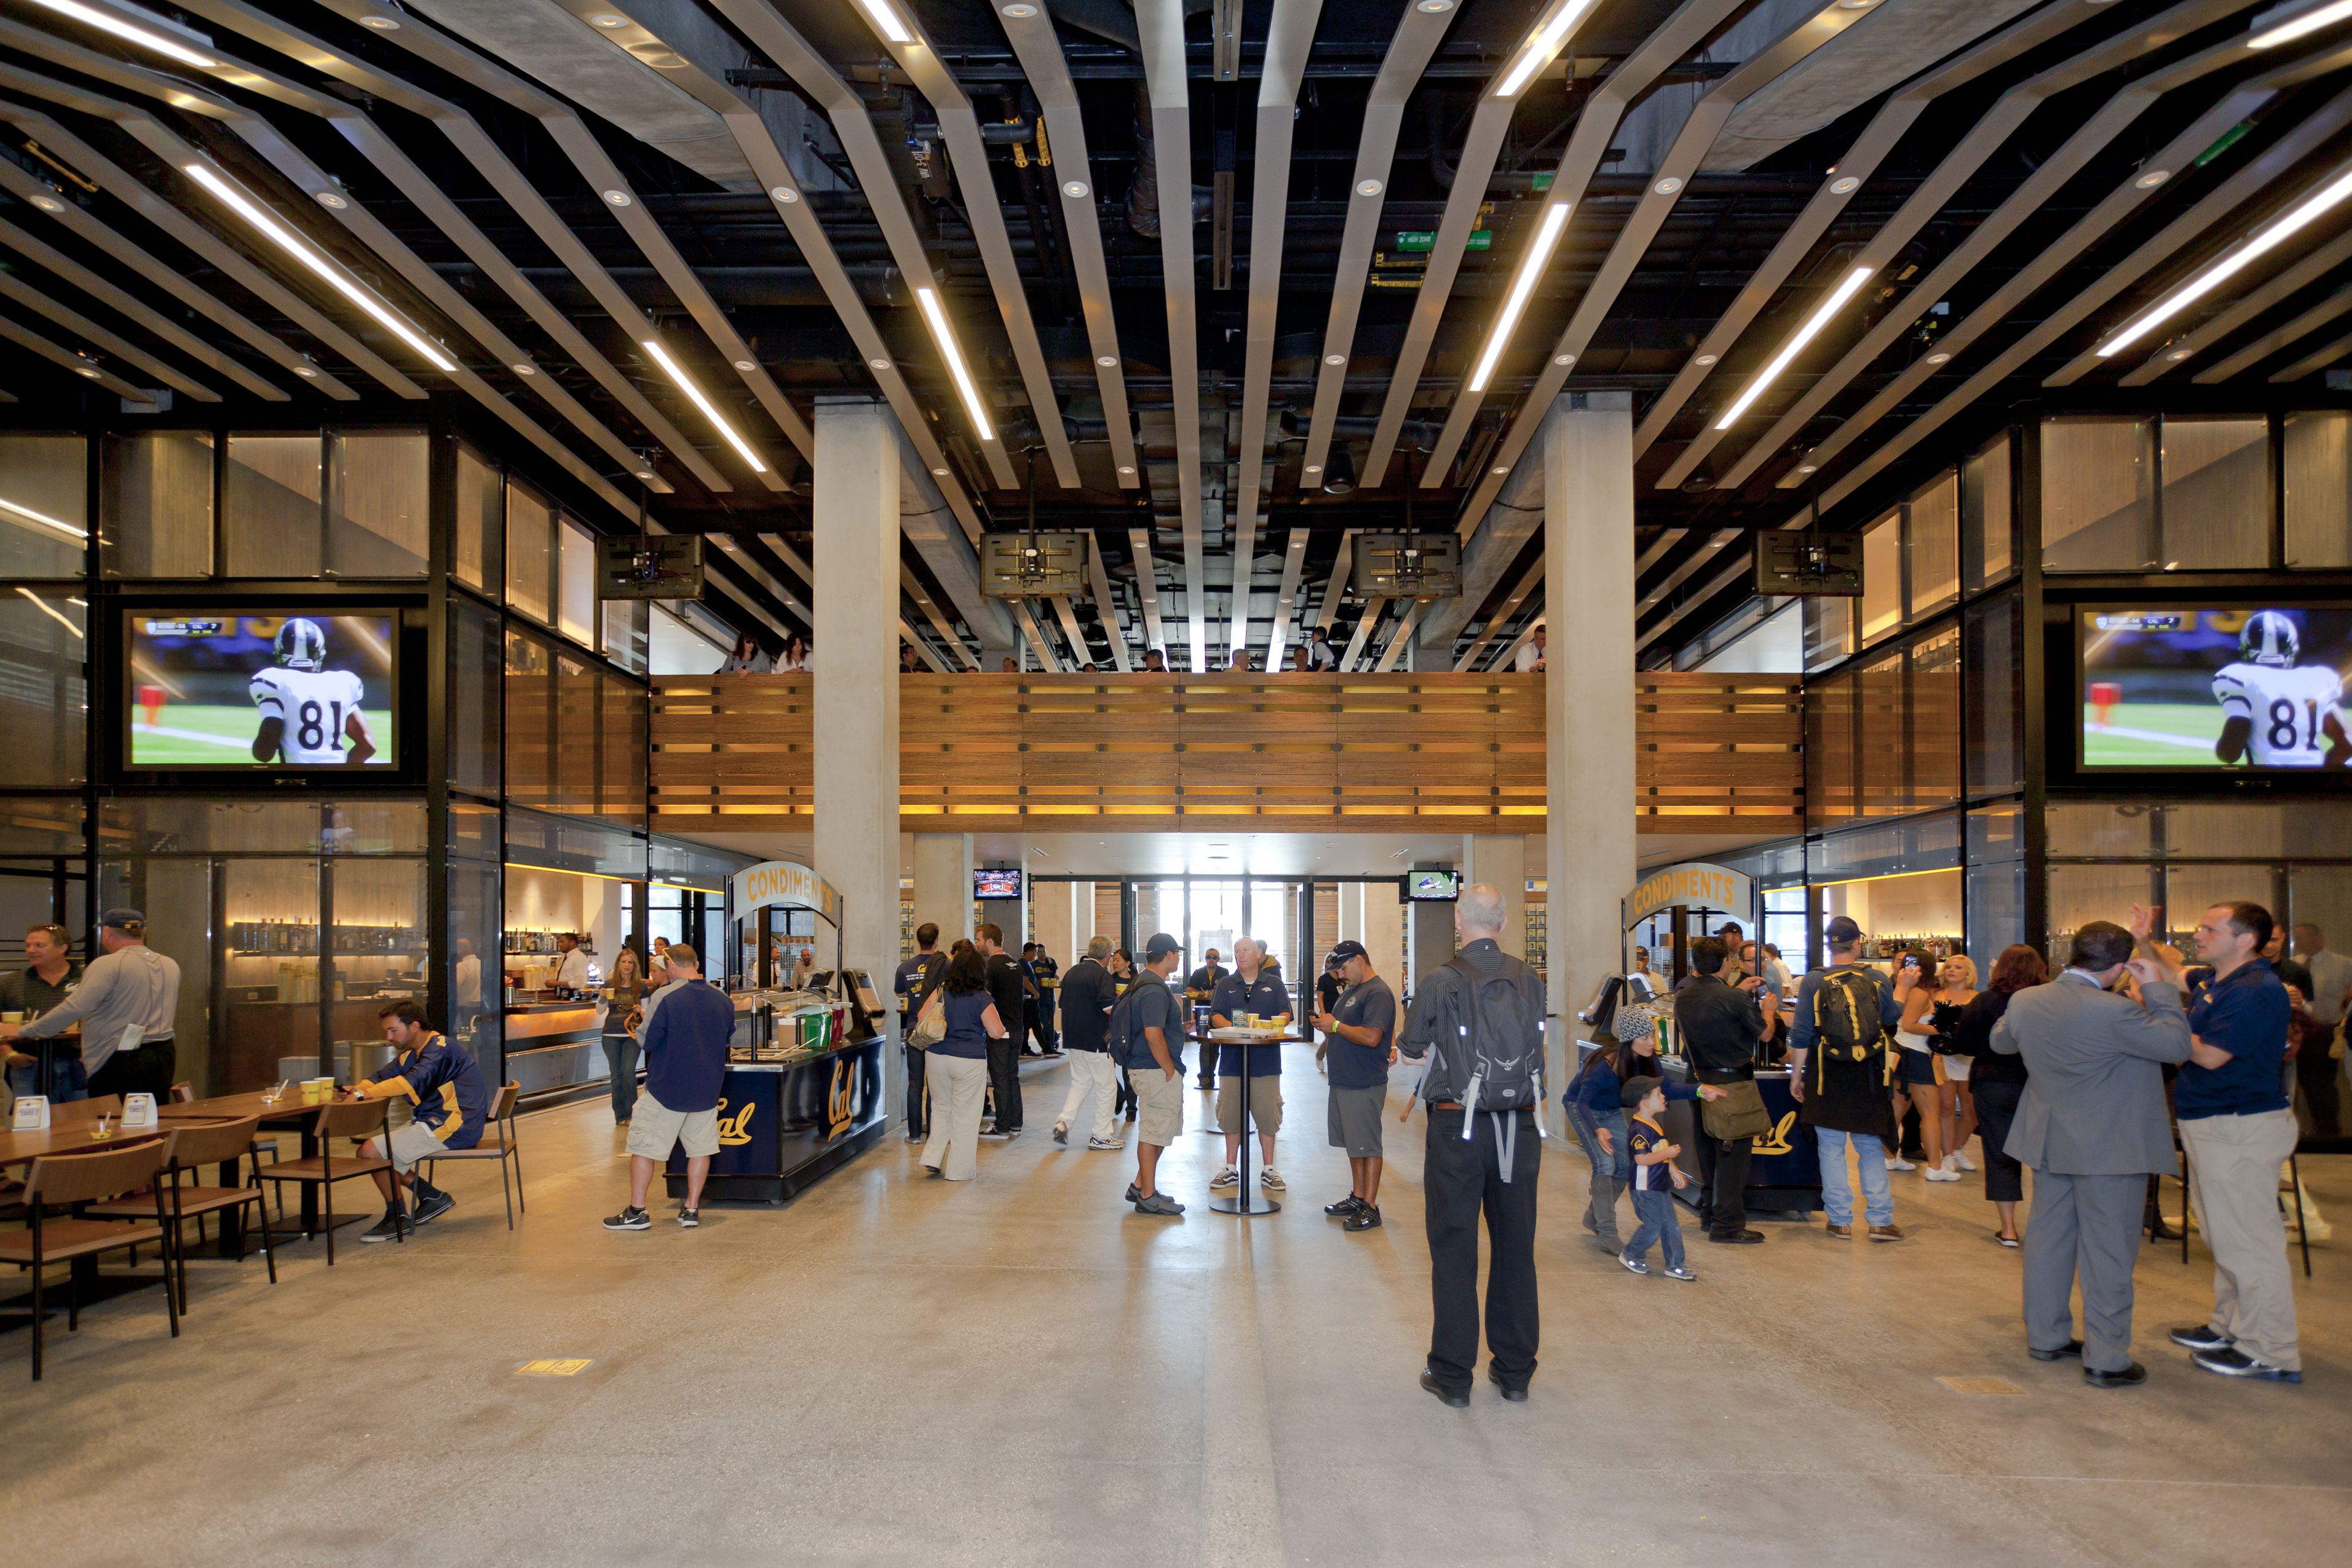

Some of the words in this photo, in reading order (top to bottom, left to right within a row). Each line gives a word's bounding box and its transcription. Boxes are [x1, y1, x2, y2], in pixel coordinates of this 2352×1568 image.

[919, 168, 930, 178] VAV
[298, 700, 344, 751] 81
[2268, 698, 2320, 751] 81
[748, 868, 833, 913] CONDIMENTS
[1634, 869, 1735, 915] CONDIMENTS
[437, 1035, 447, 1047] 1
[828, 1059, 855, 1142] Cal
